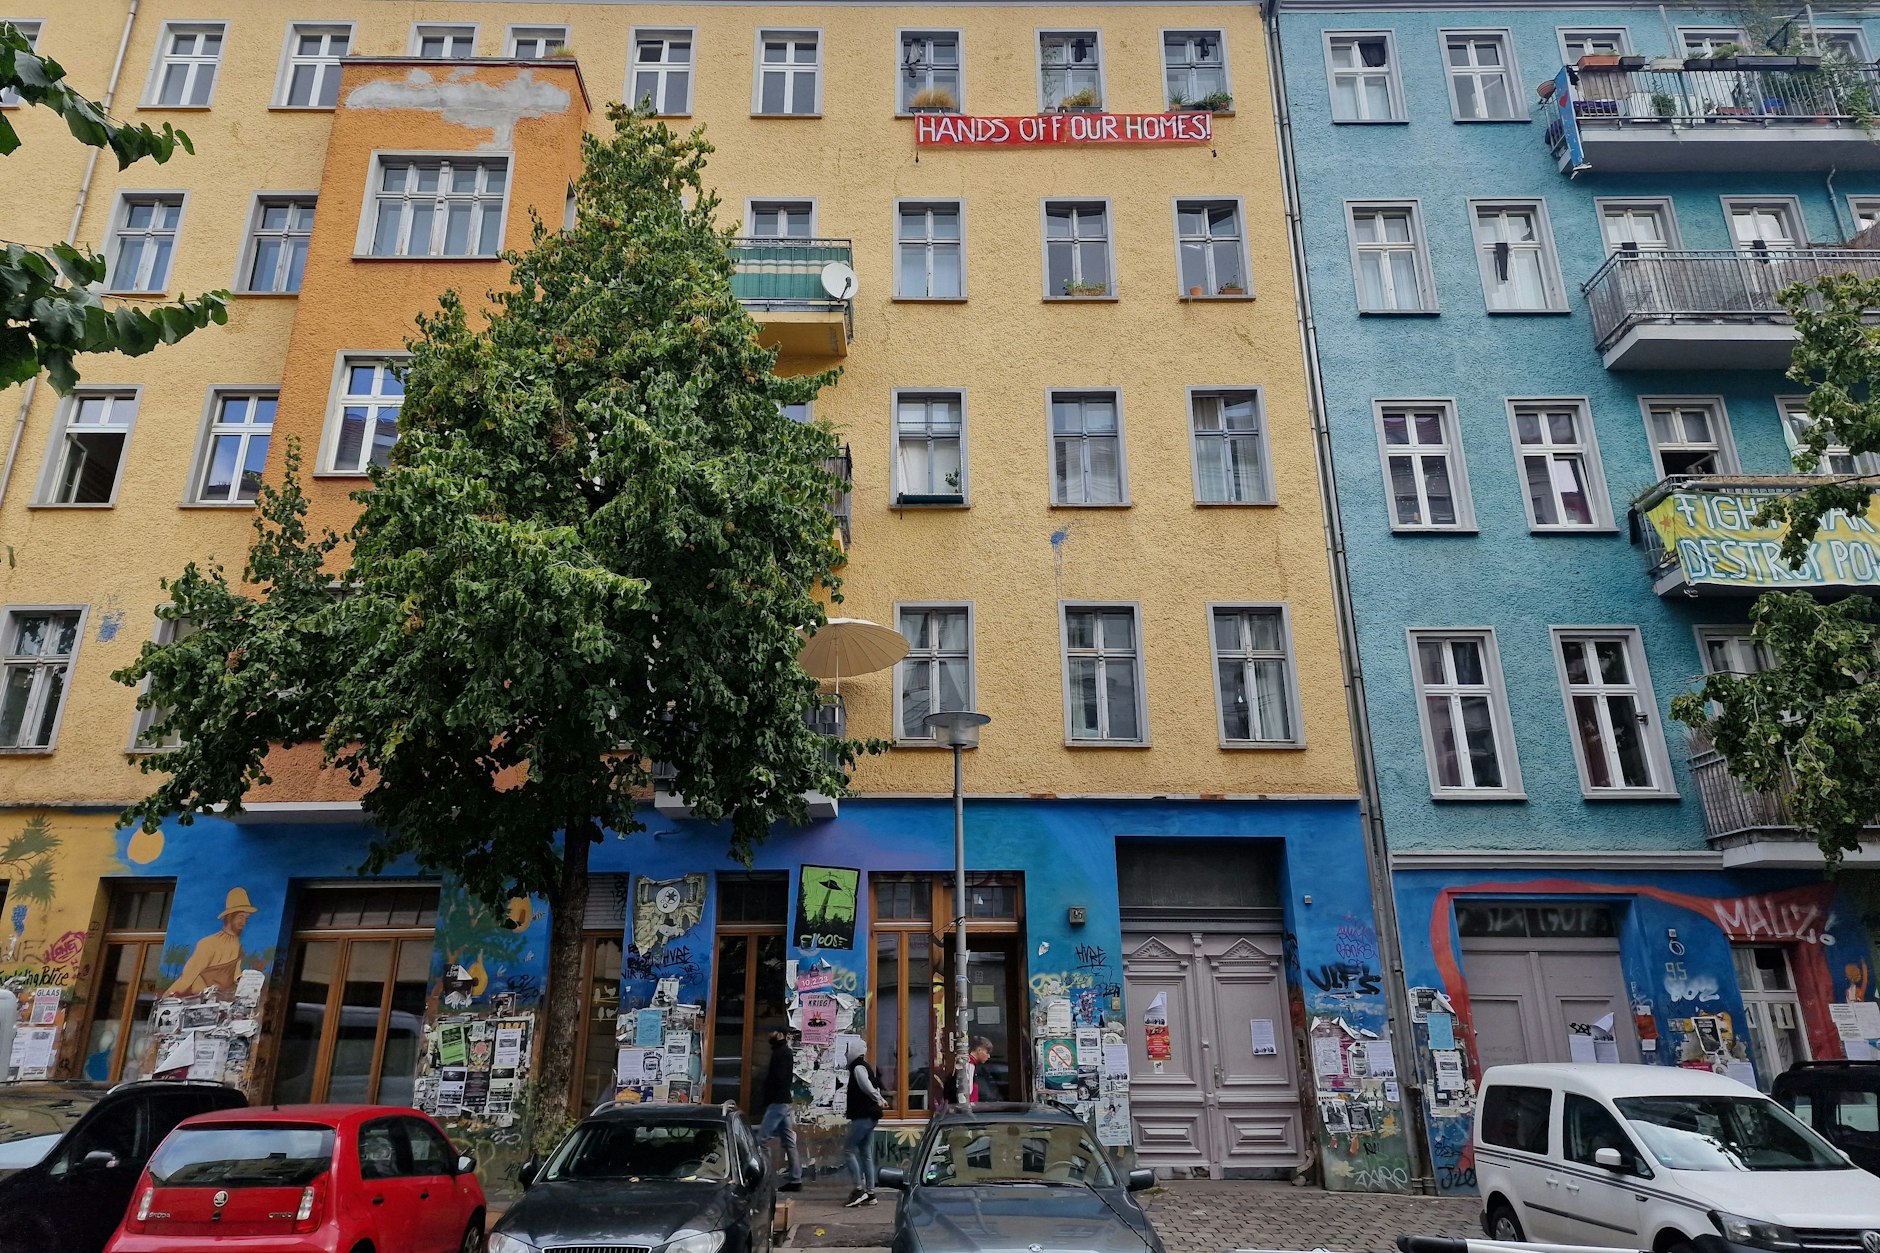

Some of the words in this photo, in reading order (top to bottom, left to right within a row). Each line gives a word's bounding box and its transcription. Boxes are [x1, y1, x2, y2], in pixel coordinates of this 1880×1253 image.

[919, 117, 1010, 143] HANDS
[1019, 115, 1063, 142] OFF
[1070, 115, 1119, 140] OUR
[1126, 114, 1211, 139] HOMES!
